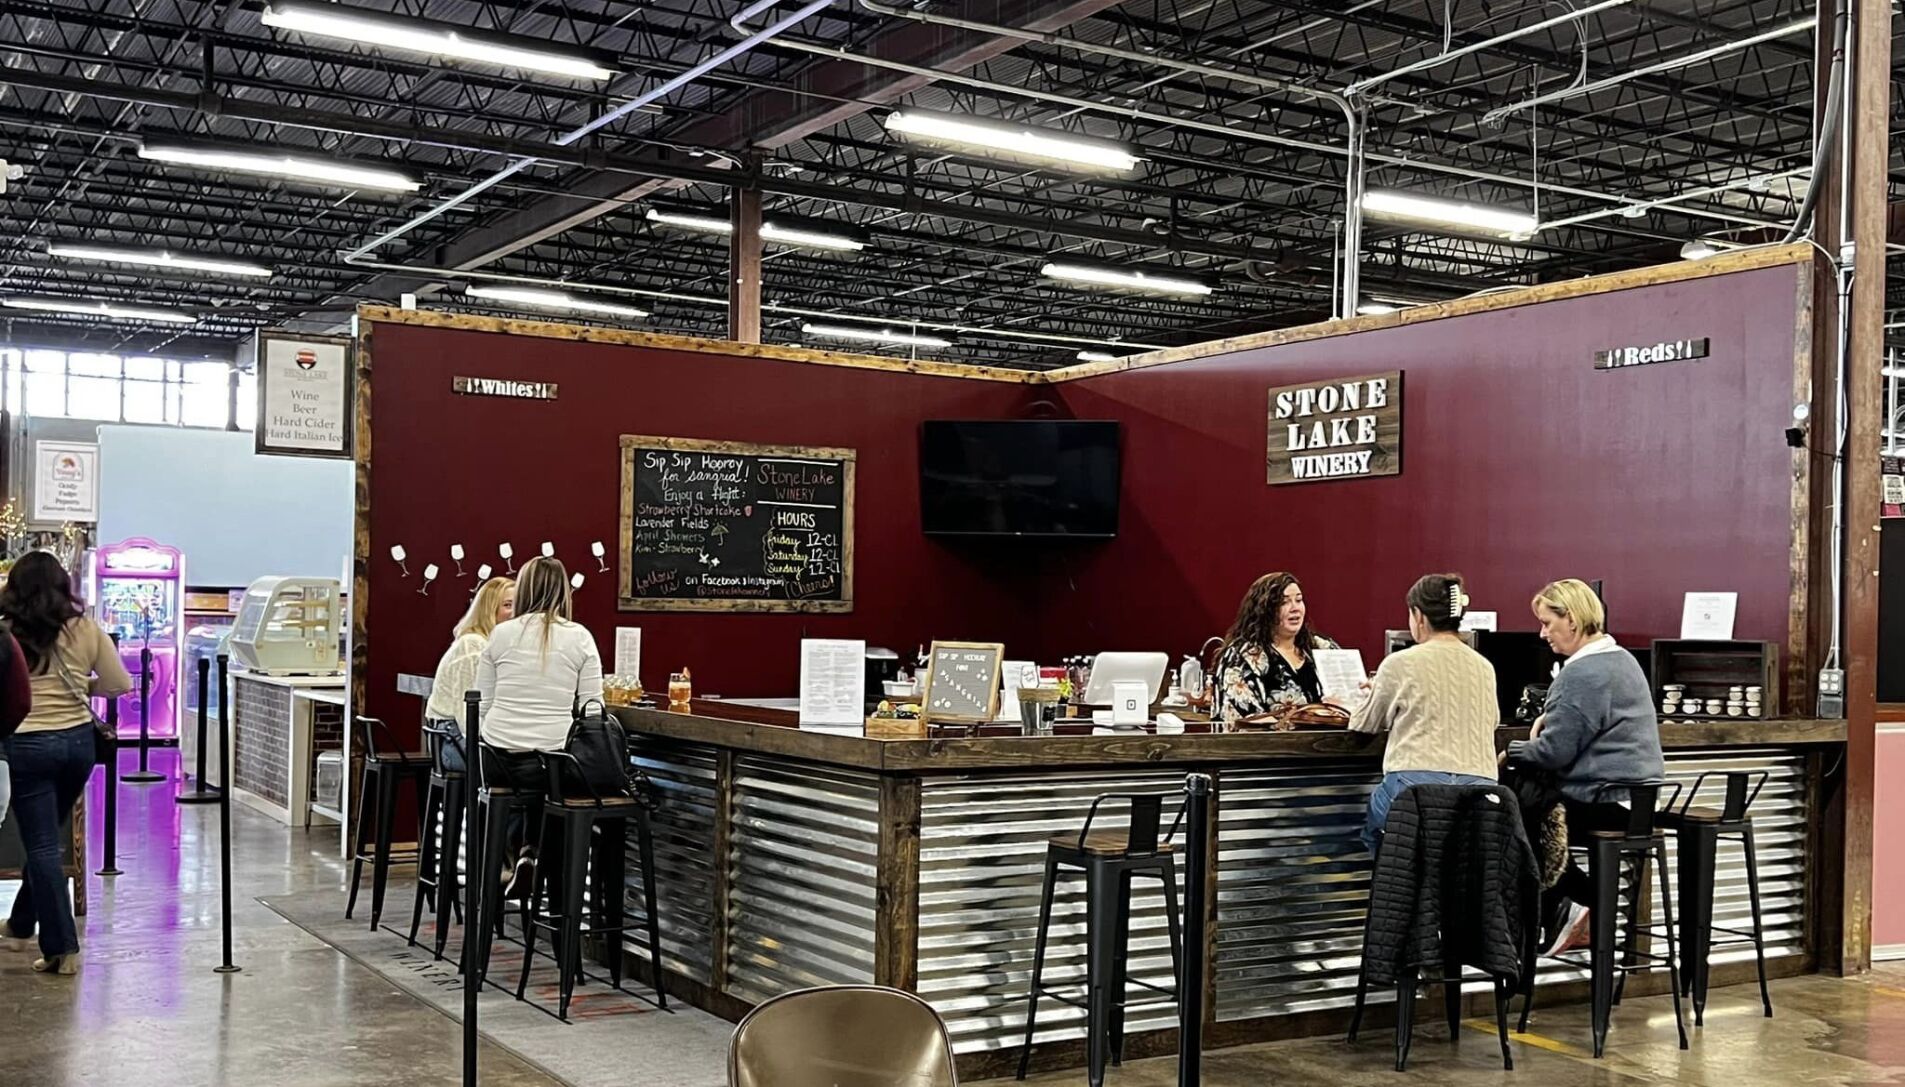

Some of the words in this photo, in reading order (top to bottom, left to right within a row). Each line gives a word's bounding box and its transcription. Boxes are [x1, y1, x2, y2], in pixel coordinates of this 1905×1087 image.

[1624, 343, 1675, 365] Reds
[291, 389, 320, 400] Wine
[480, 379, 534, 398] Whites
[1276, 378, 1387, 419] STONE
[293, 403, 317, 414] Beer
[273, 415, 302, 427] Hard
[305, 418, 335, 429] Cider
[266, 429, 292, 440] Hard
[294, 430, 326, 441] Italian
[1286, 415, 1377, 451] LAKE
[644, 452, 666, 472] Sip
[671, 452, 692, 472] Sip
[702, 455, 743, 477] Hooray
[1291, 450, 1372, 478] WINERY
[658, 468, 679, 490] for
[664, 488, 692, 508] Enjoy
[696, 491, 704, 500] a
[775, 488, 816, 502] WINERY
[638, 502, 690, 520] Strawberry
[693, 504, 742, 517] Shortcake
[777, 511, 816, 528] HOURS
[635, 516, 674, 528] Lavender
[681, 516, 709, 529] Fields
[664, 529, 706, 543] Showers
[766, 531, 801, 553] Friday
[767, 549, 809, 568] Saturday
[767, 563, 804, 580] Sunday
[685, 575, 698, 585] on
[701, 573, 741, 586] Facebook
[747, 573, 785, 590] Instagram
